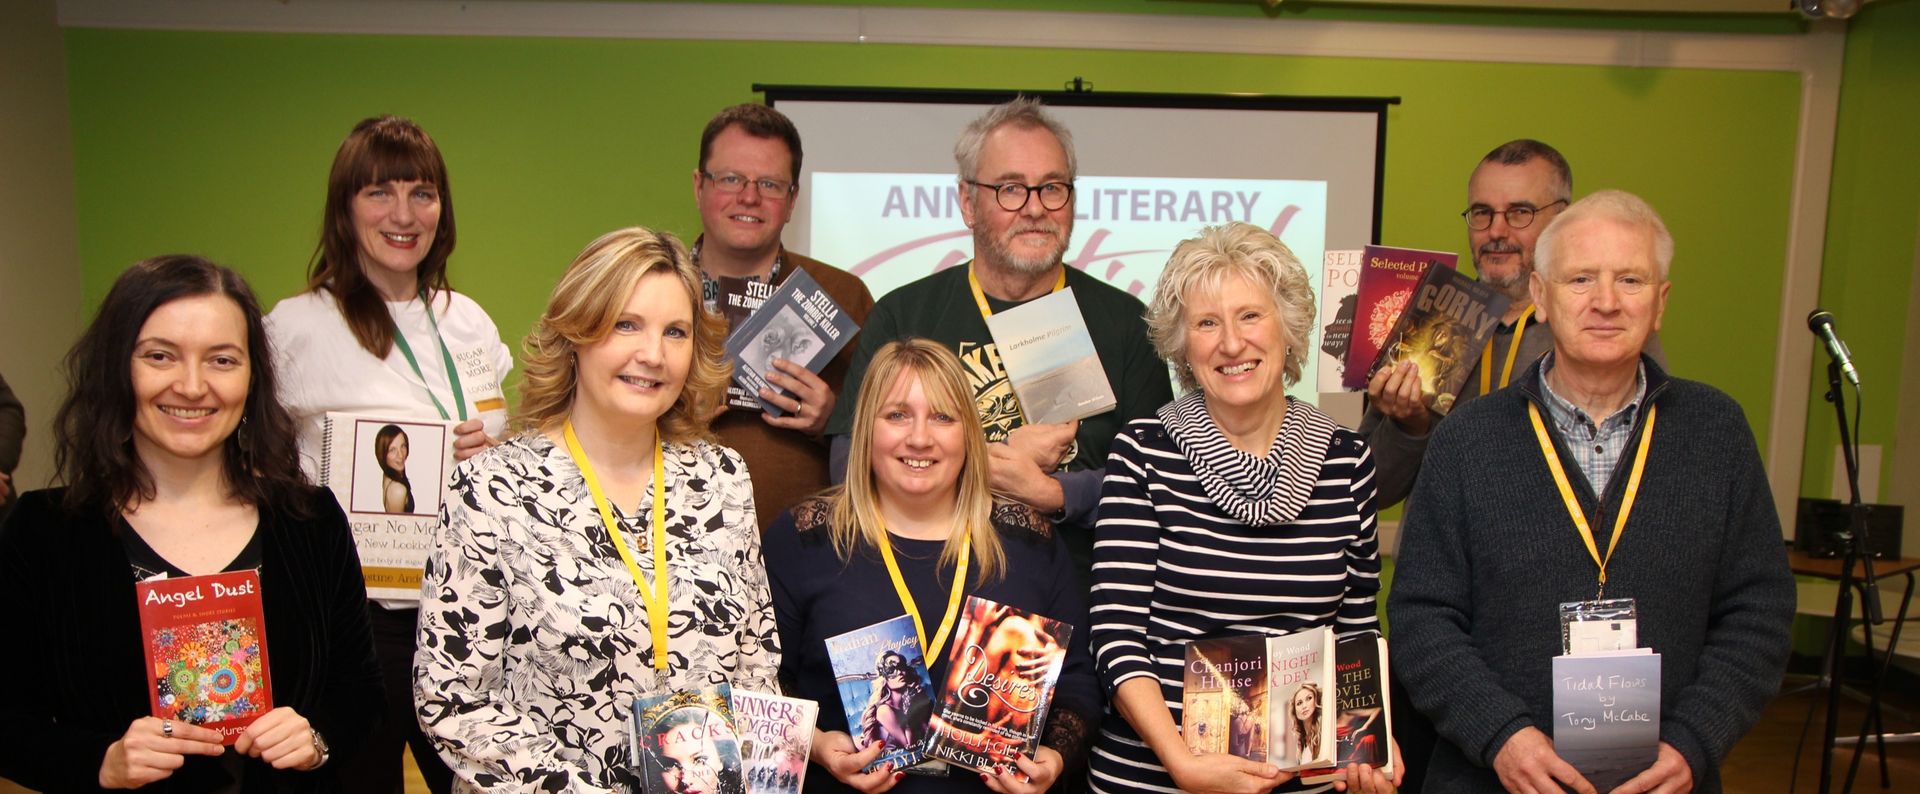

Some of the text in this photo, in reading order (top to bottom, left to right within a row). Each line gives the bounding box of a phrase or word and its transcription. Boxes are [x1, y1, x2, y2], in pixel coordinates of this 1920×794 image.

[1370, 257, 1415, 272] Selected
[746, 281, 779, 299] STELL
[728, 293, 742, 307] THE
[810, 289, 839, 322] STELLA
[791, 287, 840, 341] THE ZOMBIE KILLER
[1009, 323, 1072, 351] Larkholme Pilgrim
[1324, 340, 1344, 349] ways
[456, 346, 484, 362] SUGAR
[465, 364, 492, 377] MORE
[467, 359, 481, 368] NO
[386, 520, 407, 534] No
[365, 539, 388, 548] New
[145, 580, 254, 608] Angel Dust
[880, 635, 918, 652] Playboy
[1286, 643, 1311, 655] Wood
[1190, 656, 1262, 676] Chanjori
[1271, 651, 1318, 673] NIGHT
[1336, 660, 1361, 672] Wood
[957, 643, 1041, 713] Desires
[1201, 675, 1252, 689] House
[1283, 668, 1311, 685] DEY
[1342, 667, 1372, 684] THE
[1562, 674, 1603, 690] Tidal
[1600, 696, 1615, 706] by
[734, 694, 804, 726] SINNERS
[1562, 710, 1650, 730] Tony McCabe
[640, 721, 737, 749] CRACKS
[746, 717, 796, 745] MAGIC
[940, 726, 985, 748] HOLLY
[993, 741, 1019, 758] GIL
[935, 744, 974, 766] NIKKI
